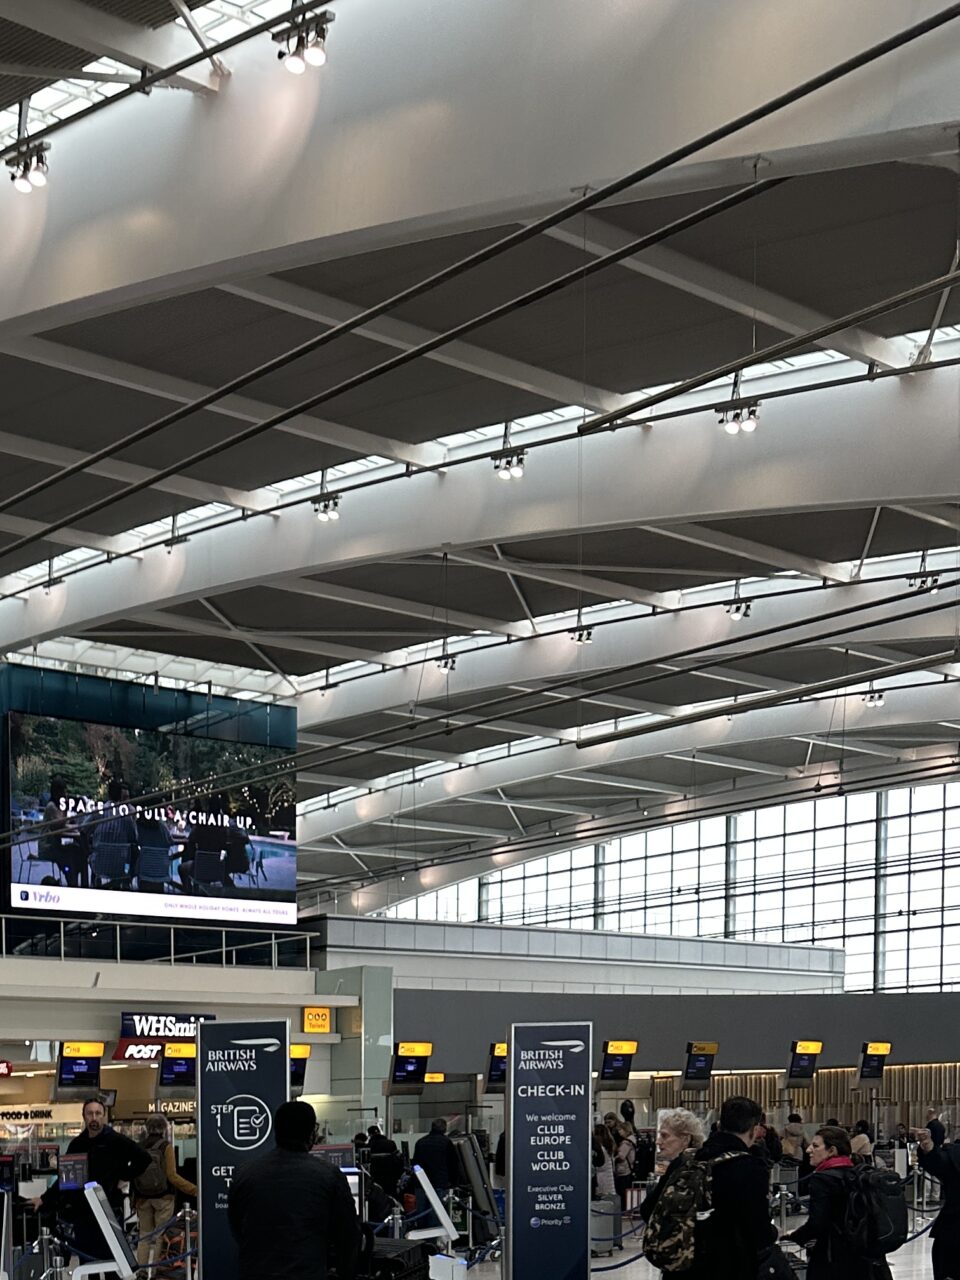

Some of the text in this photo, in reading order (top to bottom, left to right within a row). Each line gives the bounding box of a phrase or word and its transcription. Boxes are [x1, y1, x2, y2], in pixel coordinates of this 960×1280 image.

[59, 797, 104, 815] SPACE
[189, 810, 230, 828] CHAIR
[236, 815, 256, 830] UP.
[33, 890, 60, 904] Vrbo
[133, 1015, 204, 1037] WHSmi
[124, 1044, 162, 1059] POST
[208, 1049, 256, 1060] BRITISH
[520, 1050, 563, 1060] BRITISH
[205, 1060, 257, 1072] AIRWAYS
[518, 1060, 564, 1070] AIRWAYS
[517, 1084, 585, 1097] CHECK-IN
[148, 1101, 196, 1113] MGAZINE
[210, 1104, 234, 1114] STEP
[1, 1111, 22, 1120] FOOD
[30, 1109, 53, 1119] DRINK
[541, 1113, 576, 1121] welcome
[215, 1114, 221, 1127] 1
[537, 1125, 565, 1134] CLUB
[530, 1136, 572, 1145] EUROPE
[537, 1151, 565, 1160] CLUB
[212, 1166, 235, 1176] GET
[531, 1162, 570, 1171] WORLD
[224, 1178, 233, 1187] T
[559, 1184, 574, 1192] Club
[541, 1218, 562, 1226] Priority
